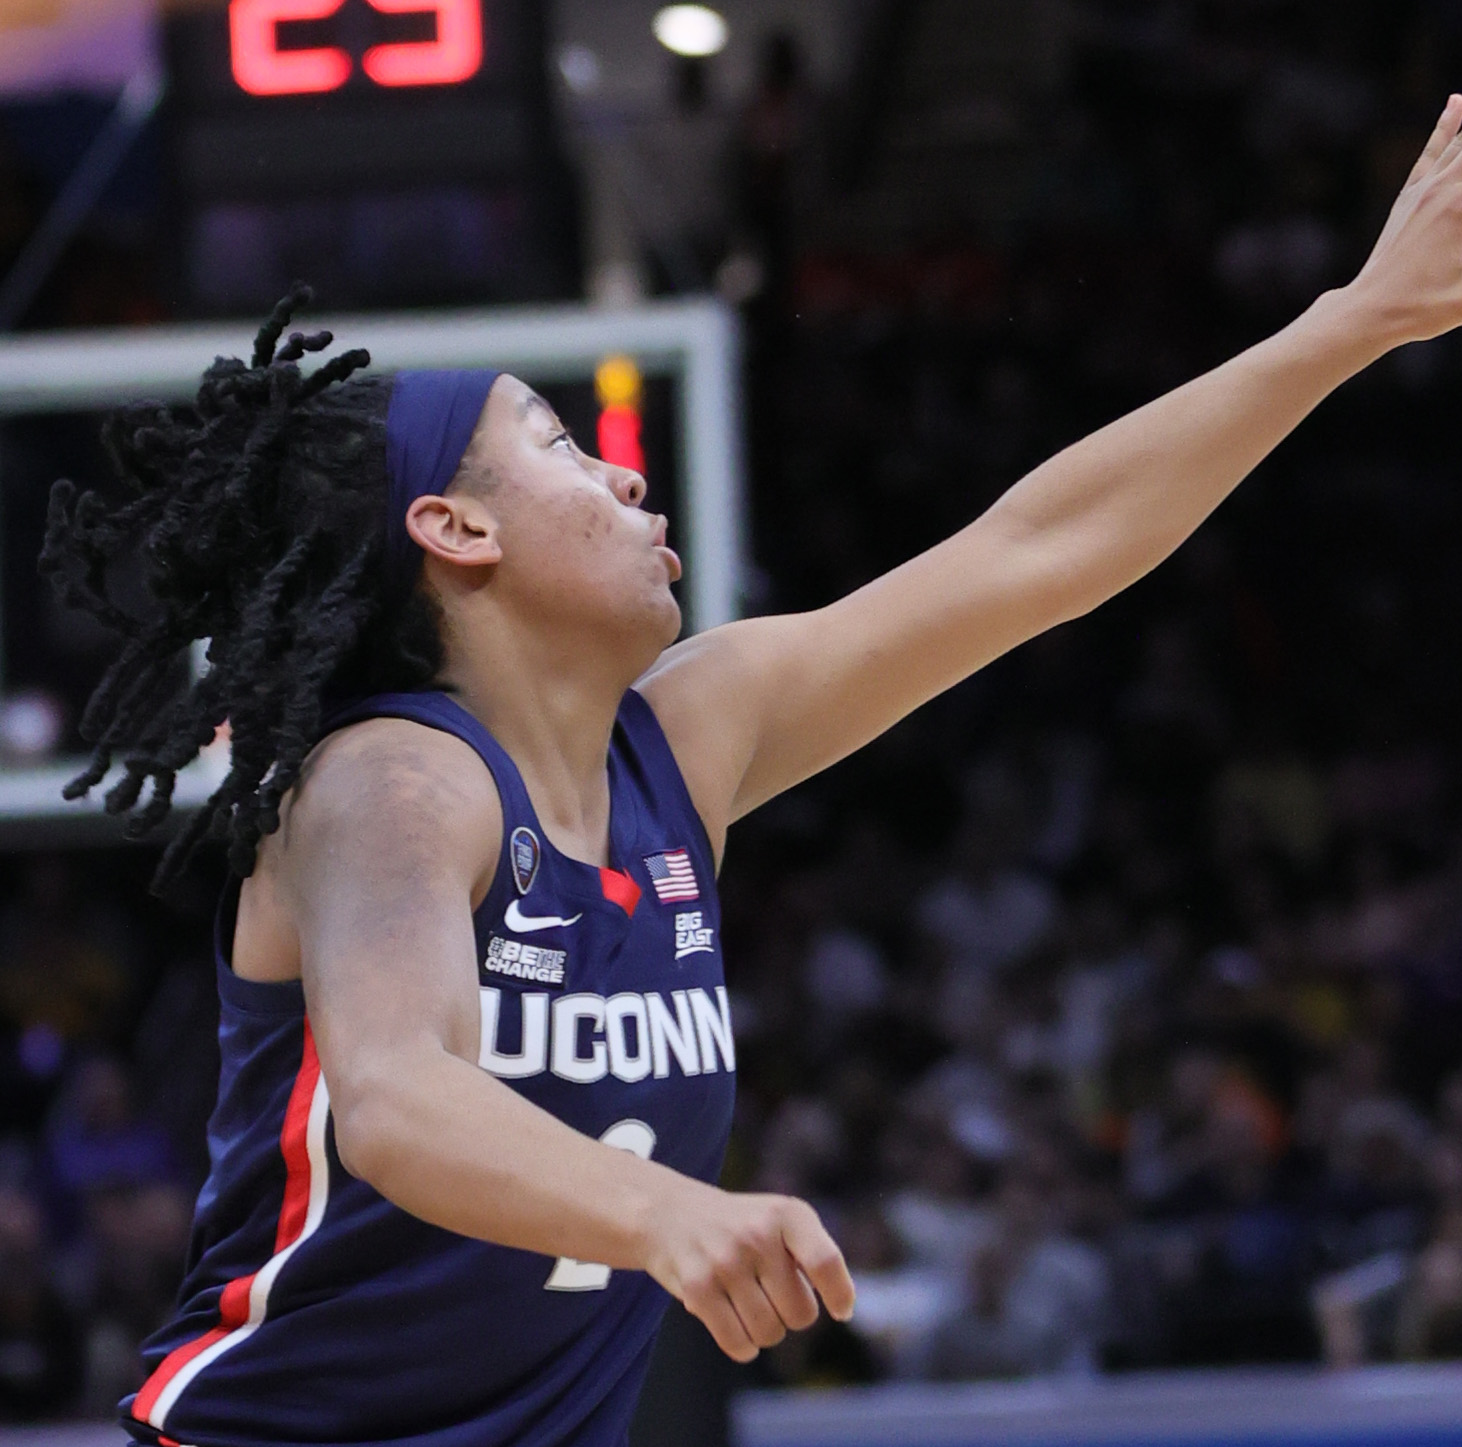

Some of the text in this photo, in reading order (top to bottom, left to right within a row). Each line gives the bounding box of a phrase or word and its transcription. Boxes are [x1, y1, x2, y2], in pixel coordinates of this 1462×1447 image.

[675, 911, 702, 931] BIG
[676, 928, 713, 949] EAST
[501, 940, 537, 965] BE
[485, 956, 565, 983] CHANGE
[478, 986, 736, 1083] UCONN
